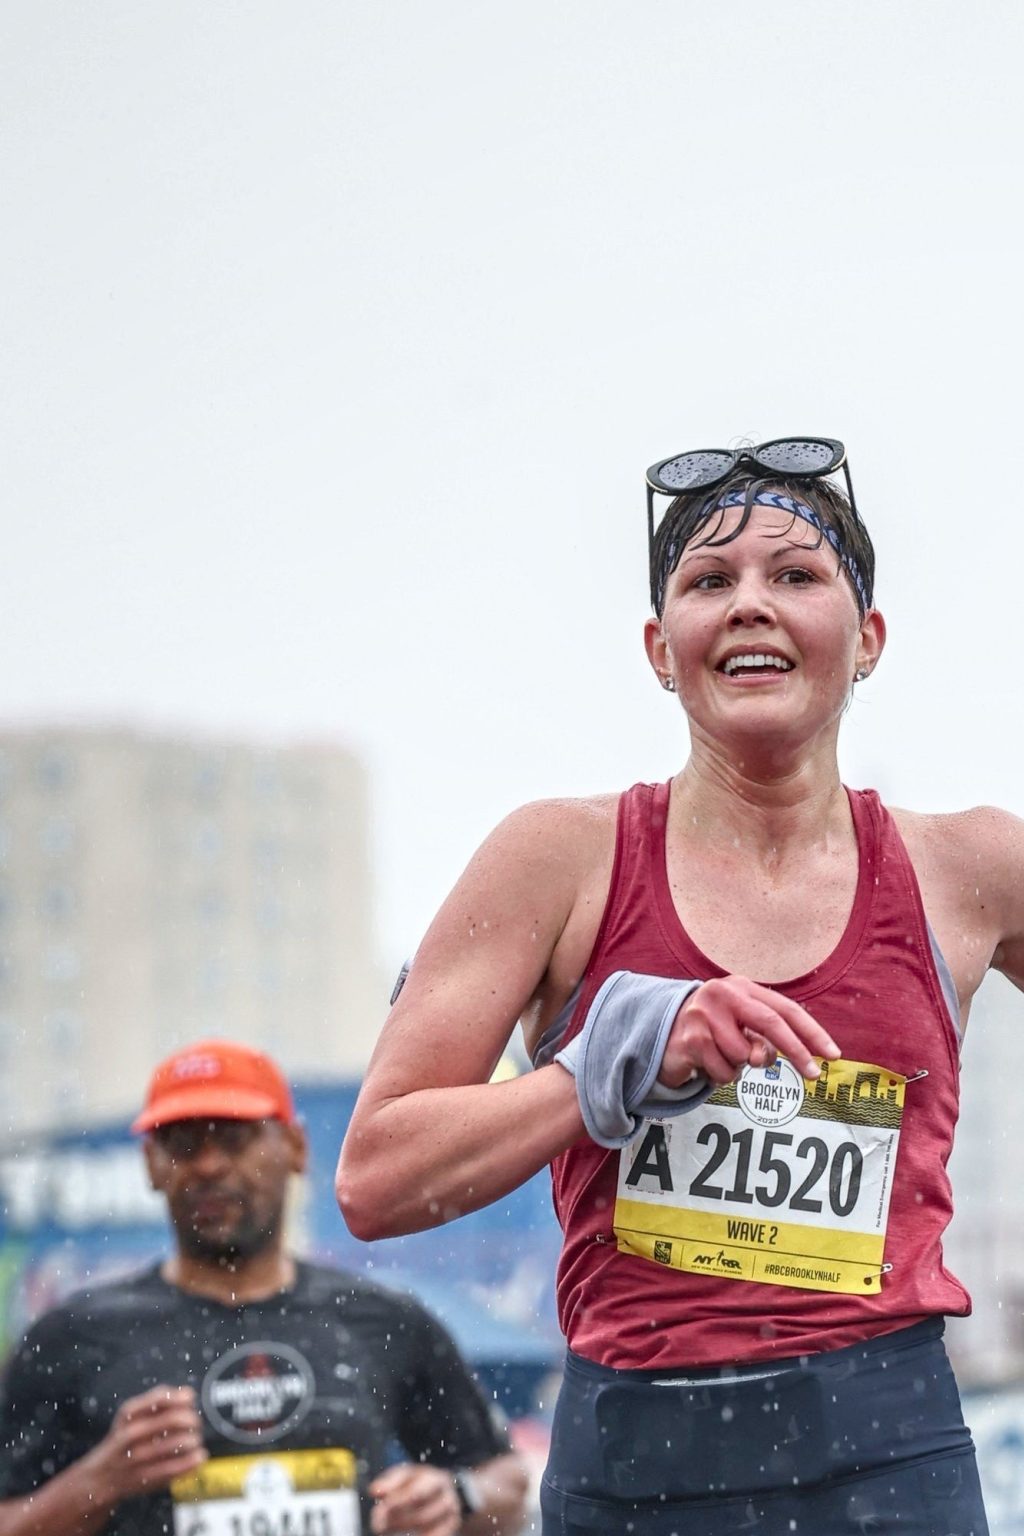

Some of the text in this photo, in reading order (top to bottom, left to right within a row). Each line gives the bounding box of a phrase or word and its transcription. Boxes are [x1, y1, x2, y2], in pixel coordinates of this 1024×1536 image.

[741, 1080, 801, 1102] BROOKLYN
[754, 1097, 784, 1113] HALF
[625, 1122, 864, 1217] A 21520
[727, 1219, 779, 1246] WAVE 2
[764, 1263, 842, 1283] #RBCBROOKLYNHALF
